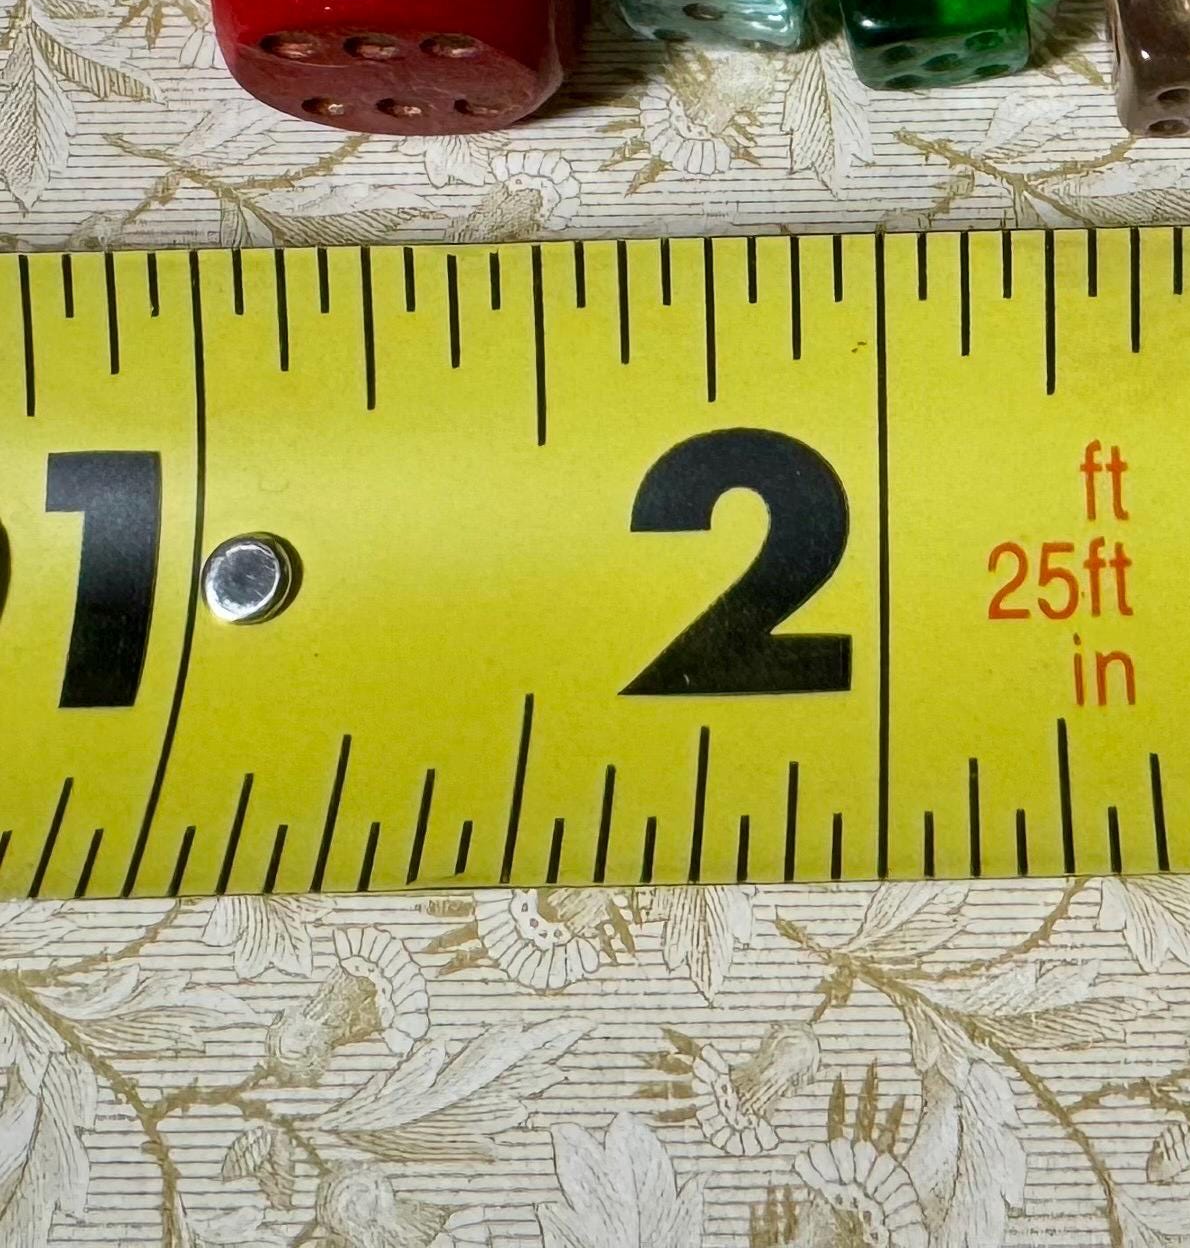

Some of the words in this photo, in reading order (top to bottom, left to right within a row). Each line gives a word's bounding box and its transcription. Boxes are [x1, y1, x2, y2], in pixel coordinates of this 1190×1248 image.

[1080, 439, 1129, 520] ft
[45, 450, 162, 708] 1
[617, 427, 853, 696] 2
[987, 535, 1133, 620] 25ft
[1073, 633, 1136, 707] in
